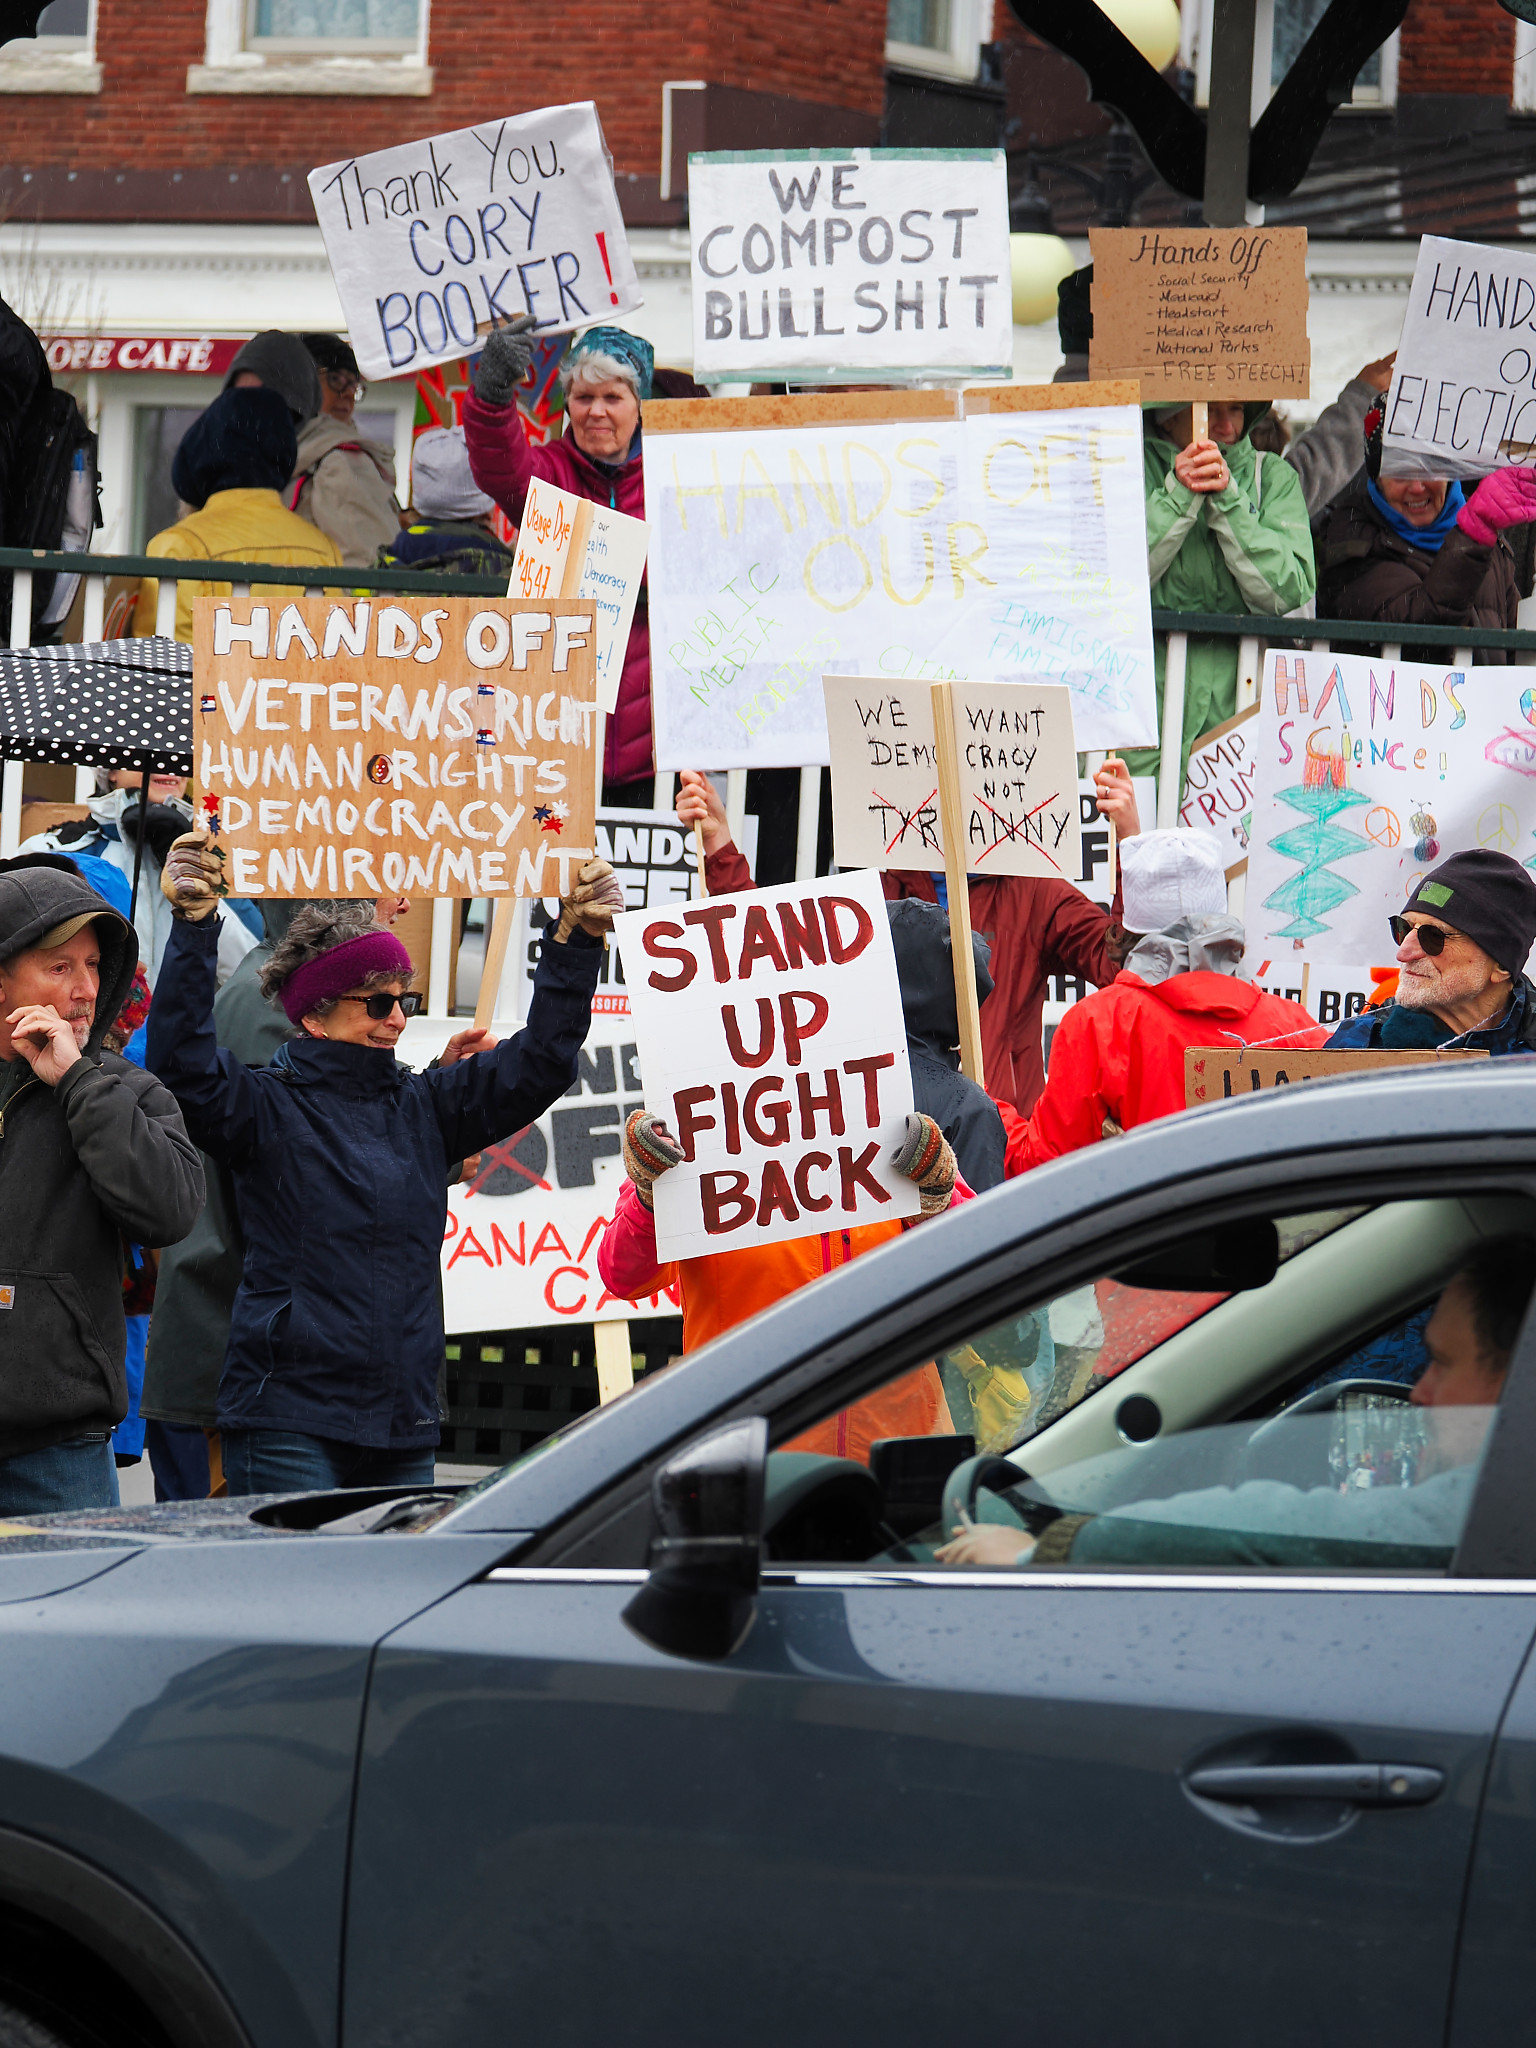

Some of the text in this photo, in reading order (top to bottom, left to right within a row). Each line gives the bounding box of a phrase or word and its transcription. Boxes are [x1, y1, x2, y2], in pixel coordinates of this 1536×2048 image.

[322, 120, 565, 231] Thank You,
[768, 165, 867, 214] WE
[410, 191, 541, 276] CORY
[699, 208, 979, 278] COMPOST
[1129, 234, 1272, 275] Hands Off
[704, 275, 999, 340] BULLSHIT
[1157, 272, 1250, 290] Social Security
[1157, 304, 1229, 319] Headstart
[1426, 262, 1536, 332] HAND
[117, 334, 214, 372] CAFÉ
[1155, 339, 1259, 355] National Parks
[1157, 320, 1274, 338] Medical Research
[1162, 360, 1306, 384] FREE SPEECH!
[526, 487, 551, 545] Orange
[673, 428, 1136, 540] HANDS OFF
[585, 557, 627, 597] Democracy
[803, 520, 998, 615] OUR
[213, 601, 449, 662] HANDS
[465, 609, 593, 673] OFF
[669, 562, 780, 677] PUBLIC
[990, 600, 1145, 687] IMMIGRANT
[689, 615, 784, 707] MEDIA
[735, 626, 842, 736] BODIES
[986, 632, 1135, 713] FAMILIES
[1274, 655, 1466, 730] HANDS
[217, 678, 475, 741] VETERANS
[855, 697, 1045, 736] WE WANT
[200, 739, 569, 797] HUMAN RIGHTS
[983, 780, 1026, 802] NOT
[222, 795, 526, 847] DEMOCRACY
[231, 840, 594, 897] ENVIRONMENT
[642, 896, 875, 993] STAND
[721, 990, 829, 1069] UP
[673, 1052, 896, 1163] FIGHT
[699, 1141, 893, 1235] BACK
